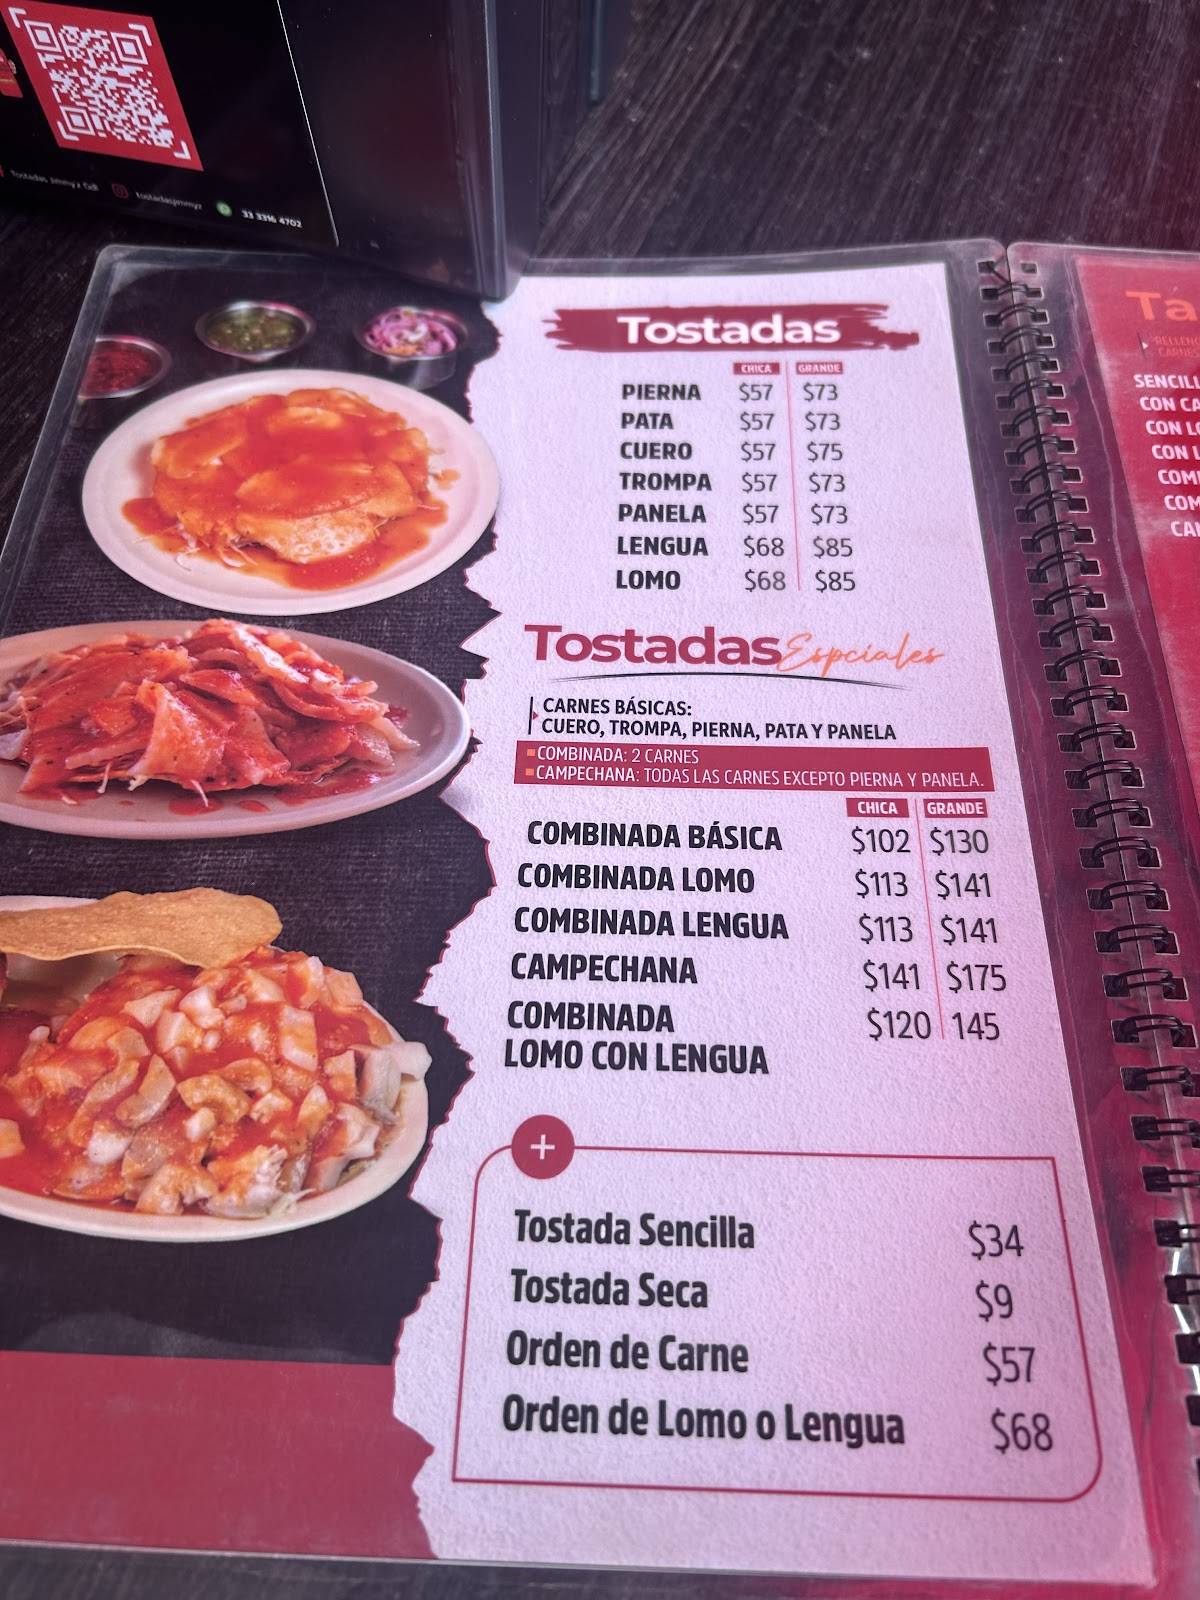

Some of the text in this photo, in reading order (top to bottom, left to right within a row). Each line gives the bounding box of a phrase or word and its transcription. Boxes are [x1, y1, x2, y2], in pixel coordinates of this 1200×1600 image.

[616, 314, 842, 345] Tostadas
[741, 364, 841, 374] CHICA GRANDE
[621, 381, 839, 403] PIERNA $57 $73
[1140, 396, 1176, 411] CON
[620, 410, 841, 433] PATA $57 $73
[1145, 420, 1183, 435] CON
[620, 440, 844, 463] CUERO $57 $75
[1151, 444, 1189, 460] CON
[619, 471, 846, 495] TROMPA $57 $73
[618, 502, 849, 526] PANELA $57 $73
[617, 535, 853, 560] LENGUA $68 $85
[616, 568, 856, 594] LOMO $68 $85
[524, 624, 945, 678] Tostadas Espciales
[543, 695, 692, 717] CARNES BÁSICAS:
[541, 717, 897, 742] CUERO, TROMPA, PIERNA, PATA Y PANELA
[537, 745, 699, 764] COMBINADA: 2 CARNES
[536, 764, 985, 789] CAMPECHANA: TODAS LAS CARNES EXCEPTO PIERNA Y PANELA.
[857, 801, 985, 816] CHICA GRANDE
[527, 820, 989, 857] COMBINADA BÁSICA $102 $130
[517, 862, 992, 901] COMBINADA LOMO $113 $141
[514, 906, 998, 947] COMBINADA LENGUA $113 $141
[511, 952, 1007, 994] CAMPECHANA $141 $175
[507, 1000, 1000, 1042] COMBINADA $120 145
[504, 1038, 770, 1075] LOMO CON LENGUA
[514, 1208, 1025, 1261] Tostada Sencilla $34
[510, 1268, 1014, 1323] Tostada Seca $9
[506, 1329, 1036, 1387] Orden de Carne $57
[502, 1393, 1054, 1455] Orden de Lomo o Lengua $68
